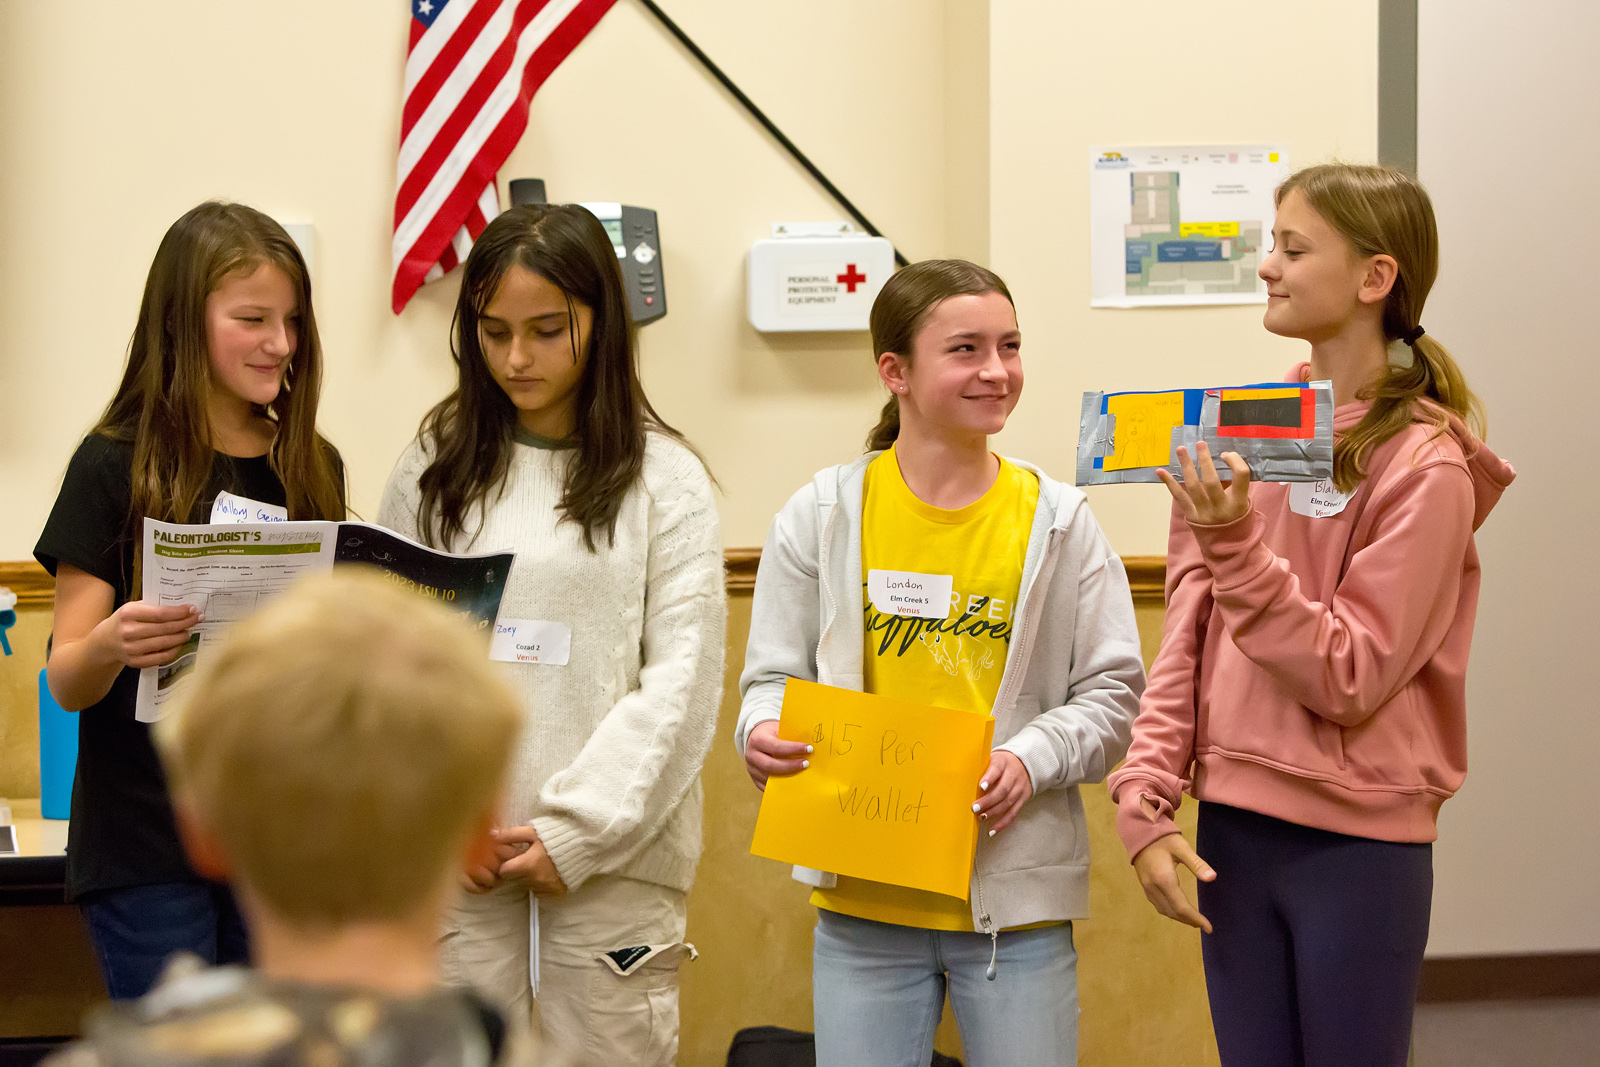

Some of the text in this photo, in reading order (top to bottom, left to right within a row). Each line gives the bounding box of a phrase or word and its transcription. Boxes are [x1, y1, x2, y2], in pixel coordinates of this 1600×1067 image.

[787, 286, 838, 294] PROTECTIVE
[787, 296, 836, 304] EQUIPMENT
[216, 498, 248, 520] Mallory
[153, 529, 262, 544] PALEONTOLOGIST'S
[384, 569, 416, 591] 2023
[886, 577, 923, 591] London
[890, 595, 903, 603] Elm
[904, 596, 923, 604] Creek
[896, 606, 921, 615] Venus
[496, 624, 517, 637] Zoey
[811, 719, 925, 766] $15 Per
[836, 784, 929, 824] Wallet
